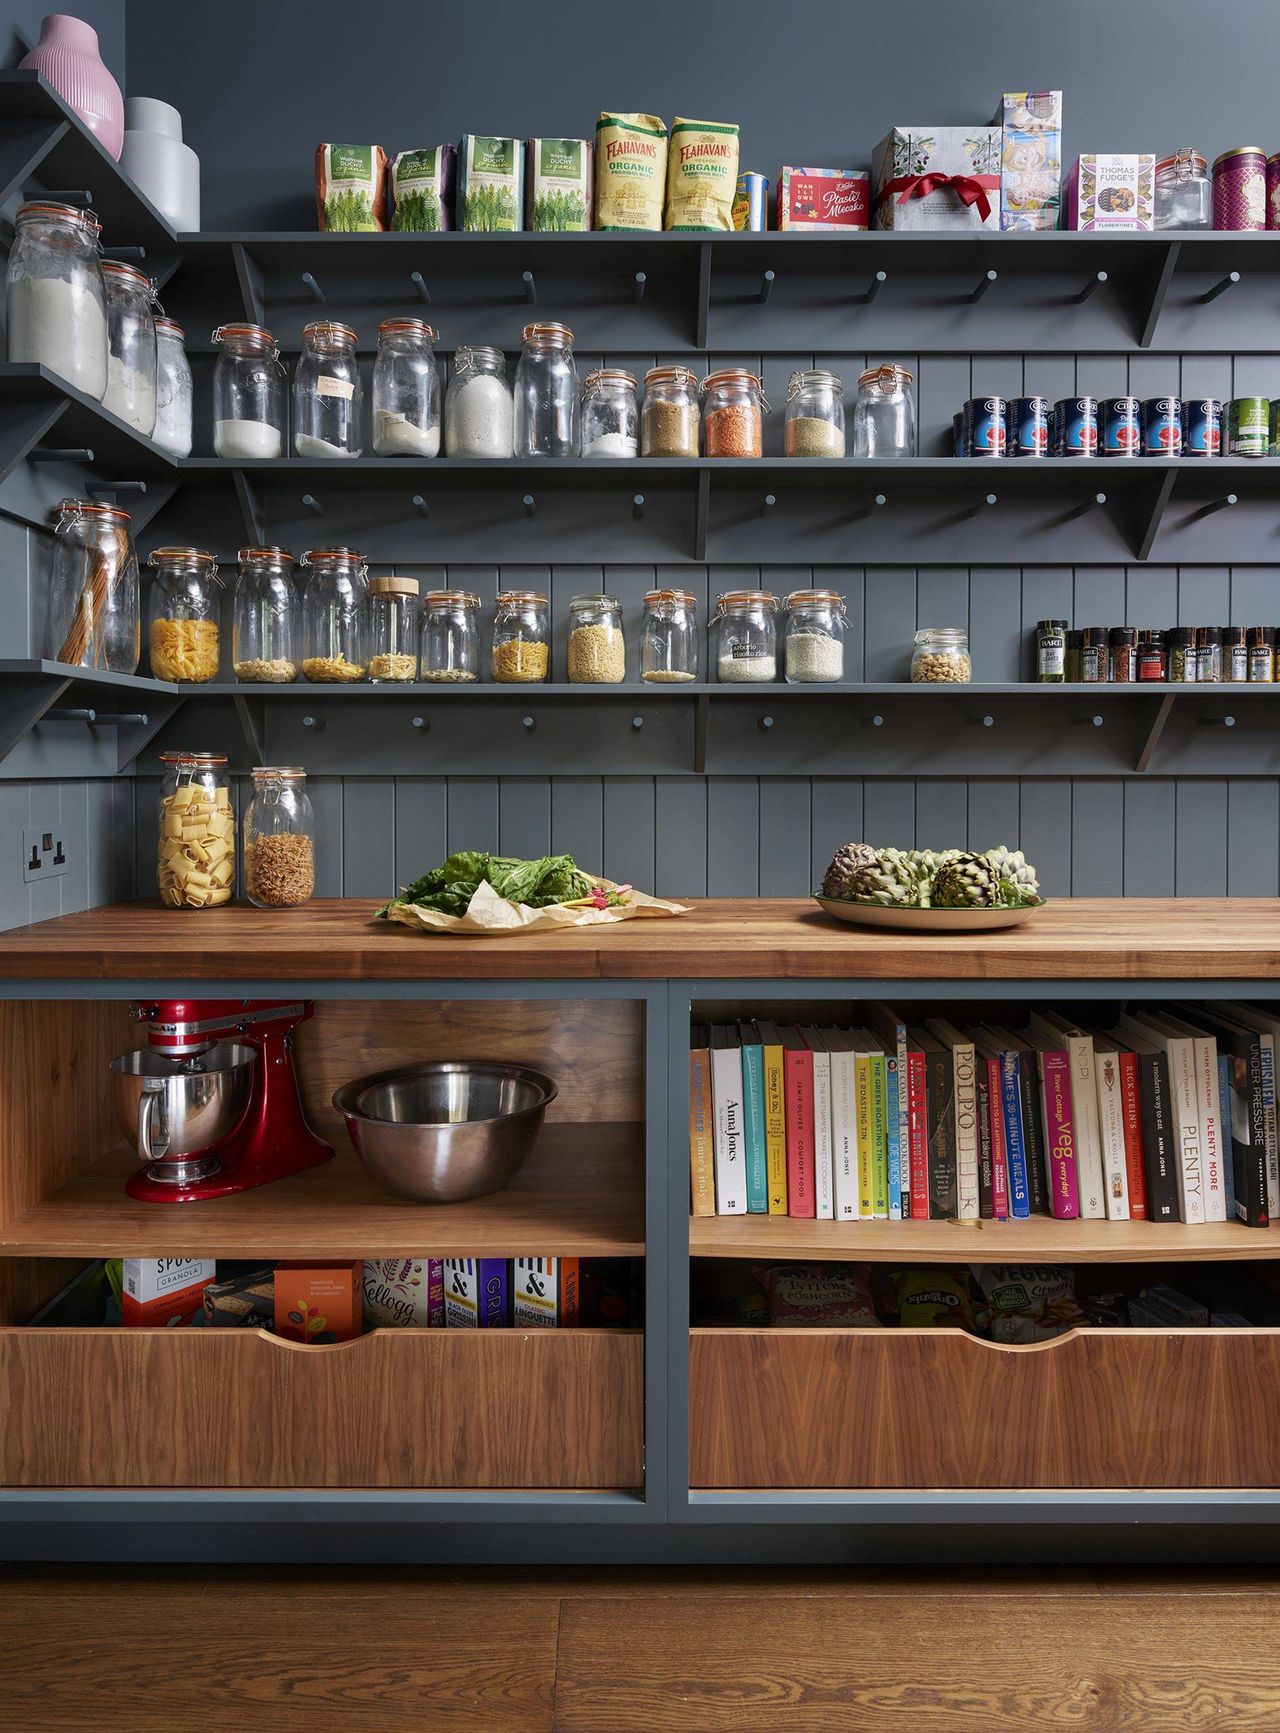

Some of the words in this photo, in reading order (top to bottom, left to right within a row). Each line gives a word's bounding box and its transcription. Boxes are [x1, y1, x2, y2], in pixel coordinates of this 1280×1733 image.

[606, 140, 657, 161] FLAHAVAN'S
[680, 143, 732, 165] FLAHAVAN'S
[340, 161, 363, 169] DUCHY
[609, 162, 654, 175] ORGANIC
[682, 164, 728, 175] ORGANIC
[733, 643, 757, 651] arborio
[1078, 1046, 1089, 1080] NOPI
[1250, 1044, 1262, 1084] UNDER
[770, 1069, 778, 1092] Honey
[956, 1050, 975, 1130] POLPO
[1004, 1056, 1017, 1102] JAMIE'S
[1054, 1074, 1062, 1093] River
[1125, 1066, 1134, 1089] RICK
[1152, 1066, 1160, 1094] modern
[727, 1099, 739, 1132] Anna
[980, 1103, 989, 1140] hummingbird
[1055, 1094, 1063, 1122] Cottage
[1108, 1099, 1116, 1131] VALVONA
[1128, 1092, 1137, 1129] STEIN'S
[1252, 1087, 1264, 1146] PRESSURE
[1267, 1107, 1275, 1132] YOTAM
[1007, 1103, 1020, 1160] 30-MINUTE
[1206, 1117, 1216, 1157] PLENTY
[695, 1136, 706, 1173] jamie's
[725, 1131, 740, 1161] Jones
[889, 1143, 899, 1156] JOE
[900, 1133, 908, 1186] COOKBOOK
[982, 1140, 990, 1160] bakery
[1268, 1134, 1277, 1180] OTTOLENGHI
[890, 1158, 900, 1184] WICKS
[983, 1161, 991, 1187] cookbook
[1182, 1126, 1200, 1196] PLENTY
[697, 1176, 708, 1198] italy
[913, 1170, 926, 1199] MEALS
[1012, 1162, 1024, 1200] MEALS
[1209, 1161, 1218, 1191] MORE
[161, 1268, 198, 1286] GRANOLA
[786, 1291, 850, 1301] POSHCORN
[447, 1307, 477, 1326] GRISSINI
[515, 1308, 556, 1328] LINGUETTE
